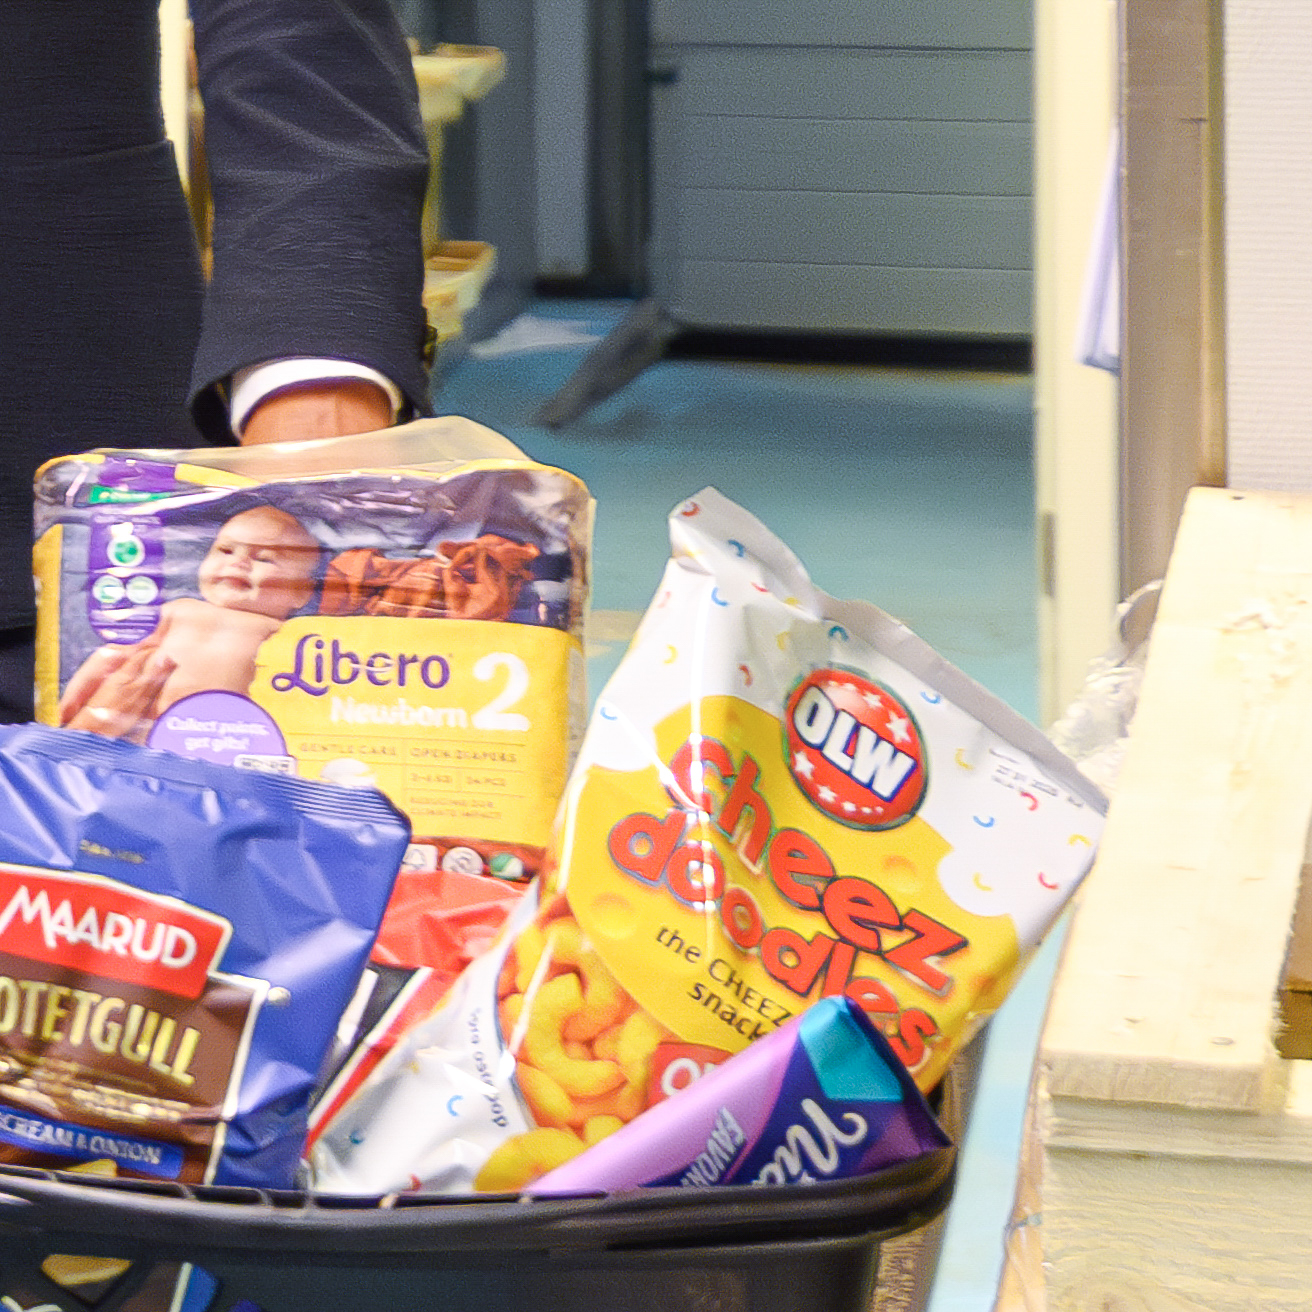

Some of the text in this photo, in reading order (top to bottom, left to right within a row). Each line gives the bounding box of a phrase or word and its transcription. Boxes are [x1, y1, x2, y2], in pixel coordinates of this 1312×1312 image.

[271, 633, 451, 697] Libero
[471, 651, 532, 732] 2
[330, 696, 469, 729] Newborn
[792, 683, 918, 804] OLW
[656, 926, 702, 964] the
[686, 981, 772, 1041] snack
[89, 1135, 162, 1165] ONION
